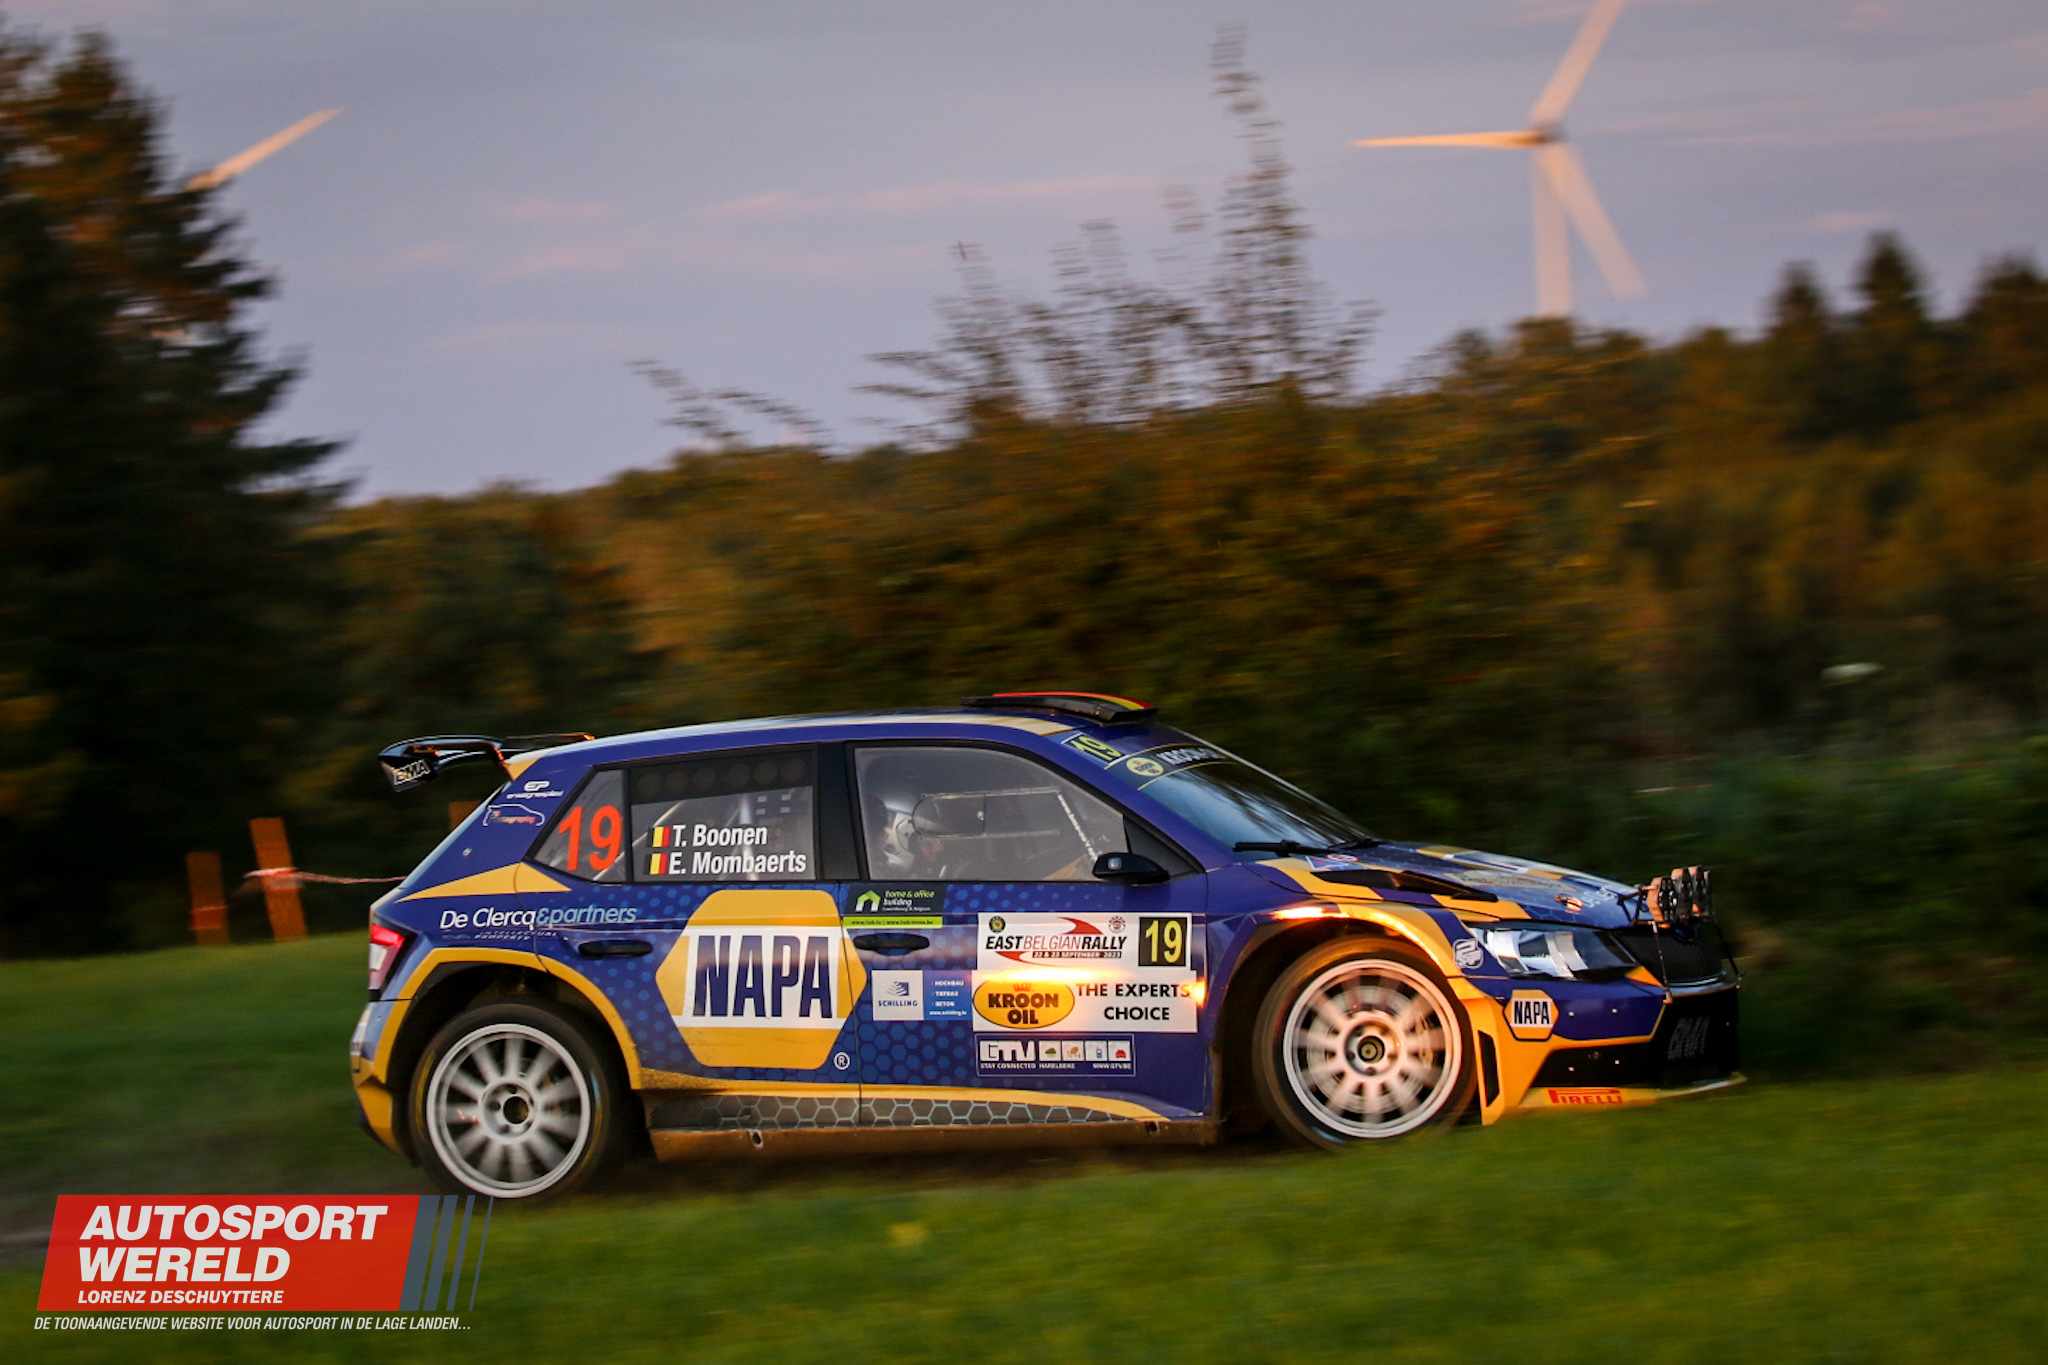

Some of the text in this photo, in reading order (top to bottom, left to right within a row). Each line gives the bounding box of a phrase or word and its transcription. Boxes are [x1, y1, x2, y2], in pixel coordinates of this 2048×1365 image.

[558, 803, 623, 873] 19
[672, 824, 768, 847] T. Boonen
[668, 850, 807, 875] E. Mombaerts
[440, 910, 468, 929] De
[1145, 919, 1183, 963] 19
[692, 935, 833, 1018] NAPA
[988, 992, 1059, 1009] KROON
[1076, 984, 1191, 998] THE EXPERTS
[1007, 1009, 1039, 1025] OIL
[1104, 1006, 1171, 1021] CHOICE
[1514, 1001, 1550, 1025] NAPA
[1548, 1088, 1623, 1106] PIRELLI
